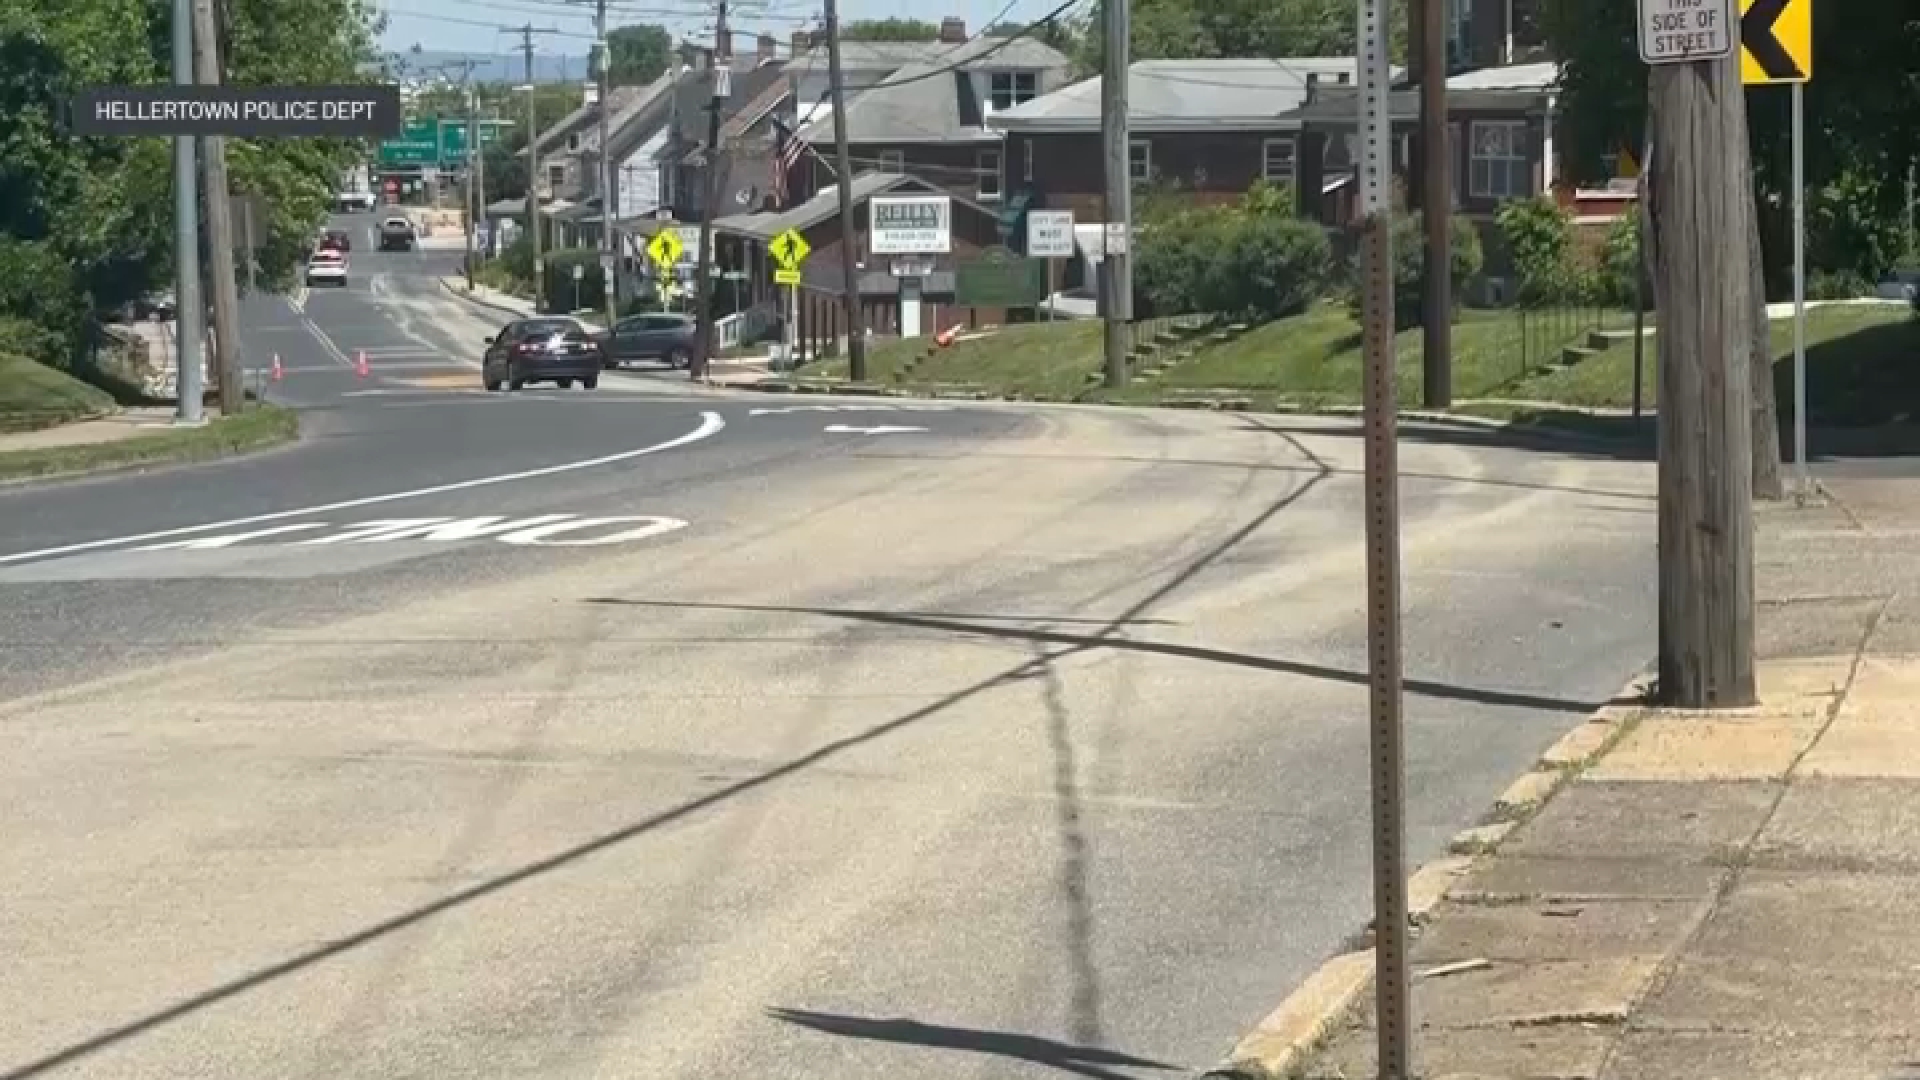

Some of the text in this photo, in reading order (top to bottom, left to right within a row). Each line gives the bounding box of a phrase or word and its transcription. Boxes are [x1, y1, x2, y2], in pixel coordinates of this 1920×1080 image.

[1652, 9, 1717, 32] SIDE OF
[1655, 32, 1716, 53] STREET
